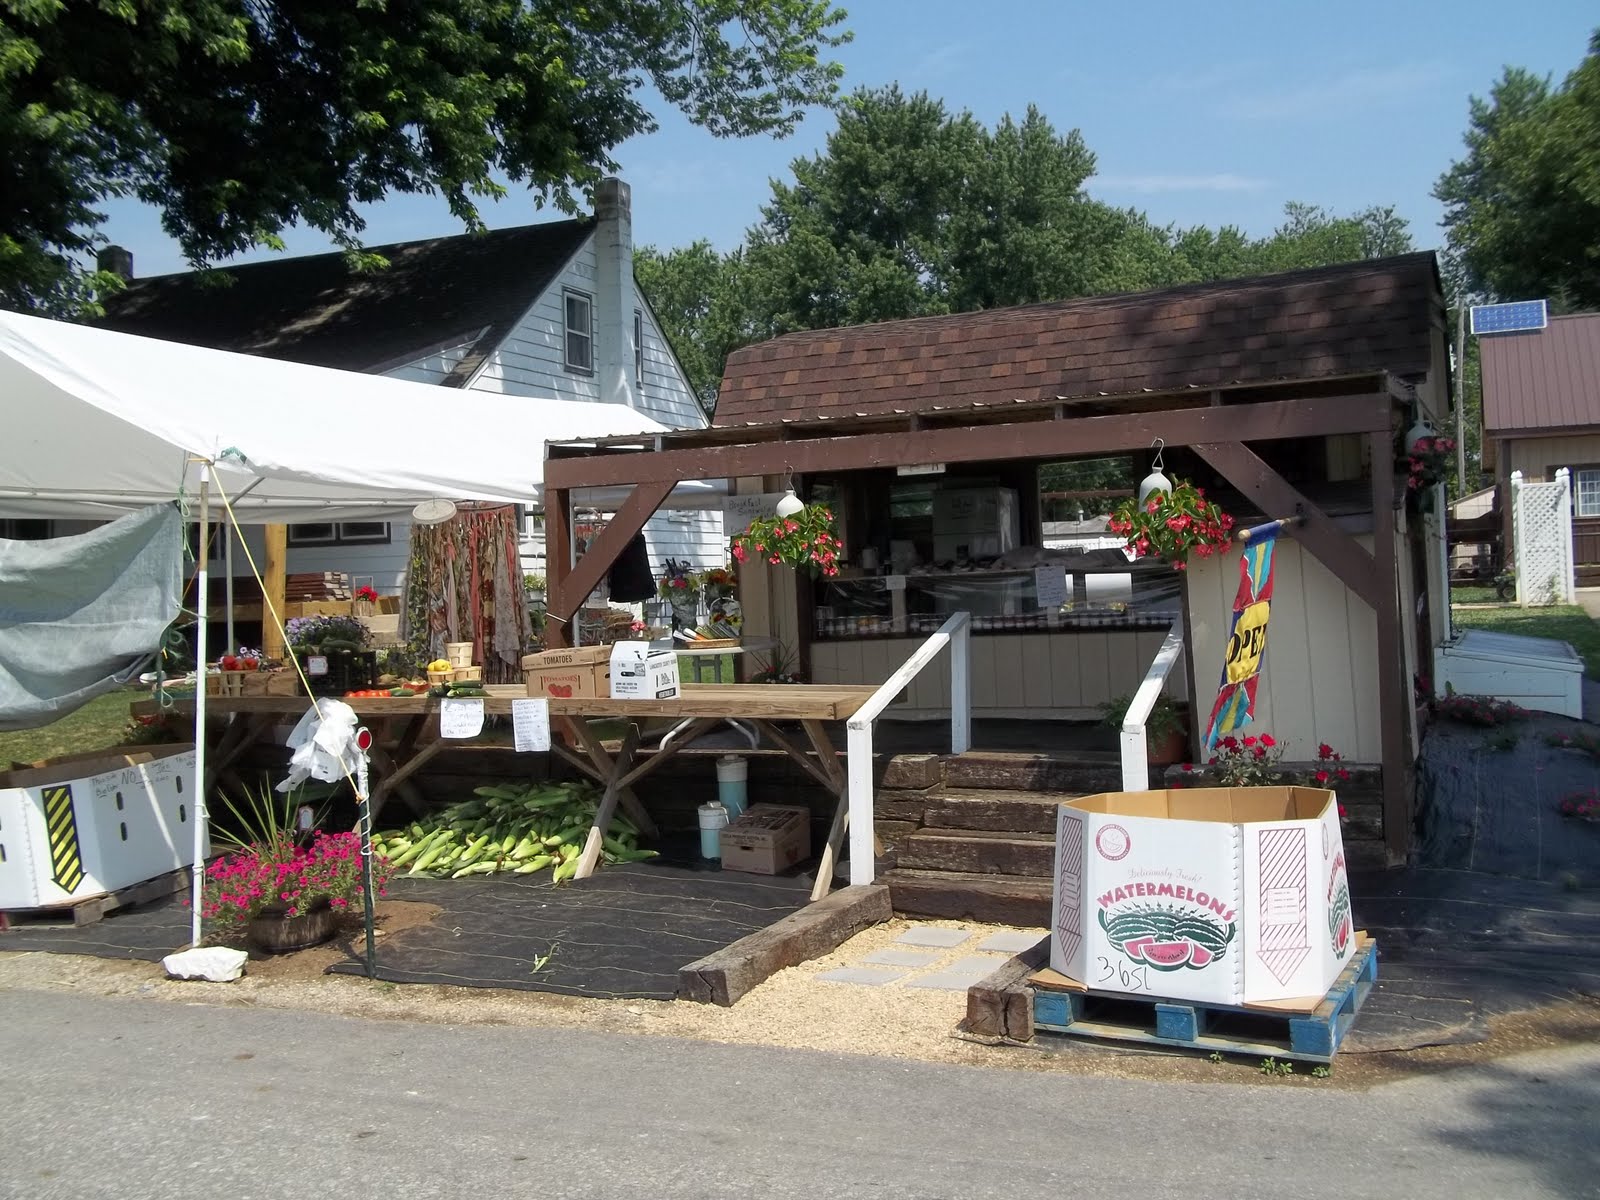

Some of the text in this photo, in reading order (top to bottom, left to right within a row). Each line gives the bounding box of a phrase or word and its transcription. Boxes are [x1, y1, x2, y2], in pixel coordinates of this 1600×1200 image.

[543, 654, 573, 666] TOMATOES
[543, 674, 578, 683] TOMATOES
[121, 770, 136, 784] NO
[1127, 866, 1173, 880] Deliciously
[1097, 882, 1237, 921] WATERMELONS
